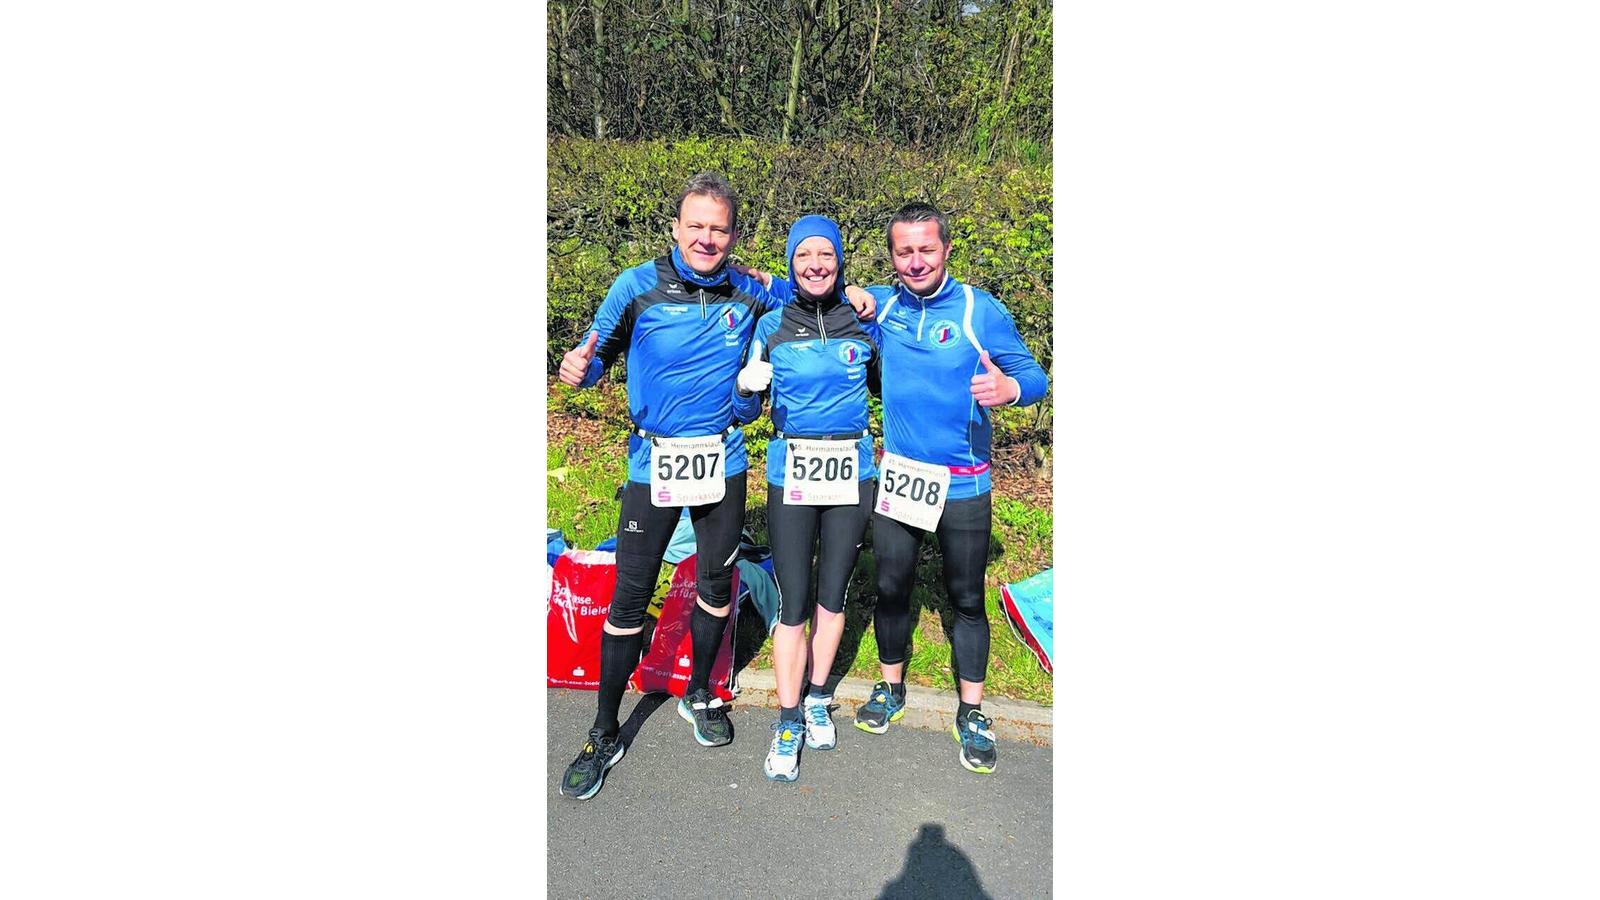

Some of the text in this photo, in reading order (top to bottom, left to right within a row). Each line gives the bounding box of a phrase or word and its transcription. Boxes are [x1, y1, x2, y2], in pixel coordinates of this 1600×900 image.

[657, 452, 720, 481] 5207
[792, 456, 853, 482] 5206
[884, 468, 941, 506] 5208
